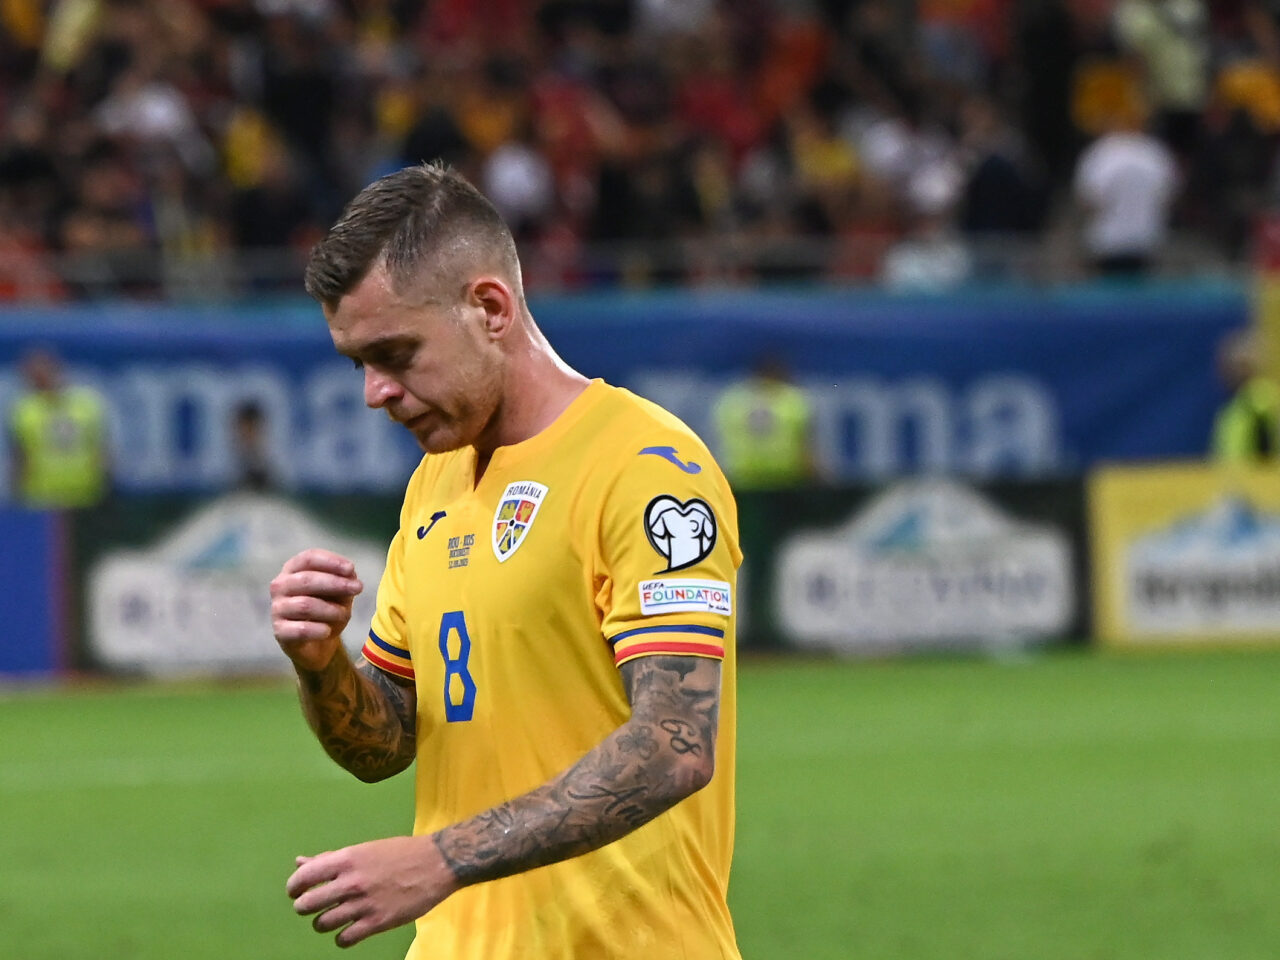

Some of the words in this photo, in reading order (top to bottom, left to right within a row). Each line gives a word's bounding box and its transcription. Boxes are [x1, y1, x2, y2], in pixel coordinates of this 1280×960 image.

[506, 484, 542, 499] ROMÂNIA
[642, 582, 664, 590] UEFA
[643, 589, 729, 603] FOUNDATION
[438, 610, 477, 723] 8
